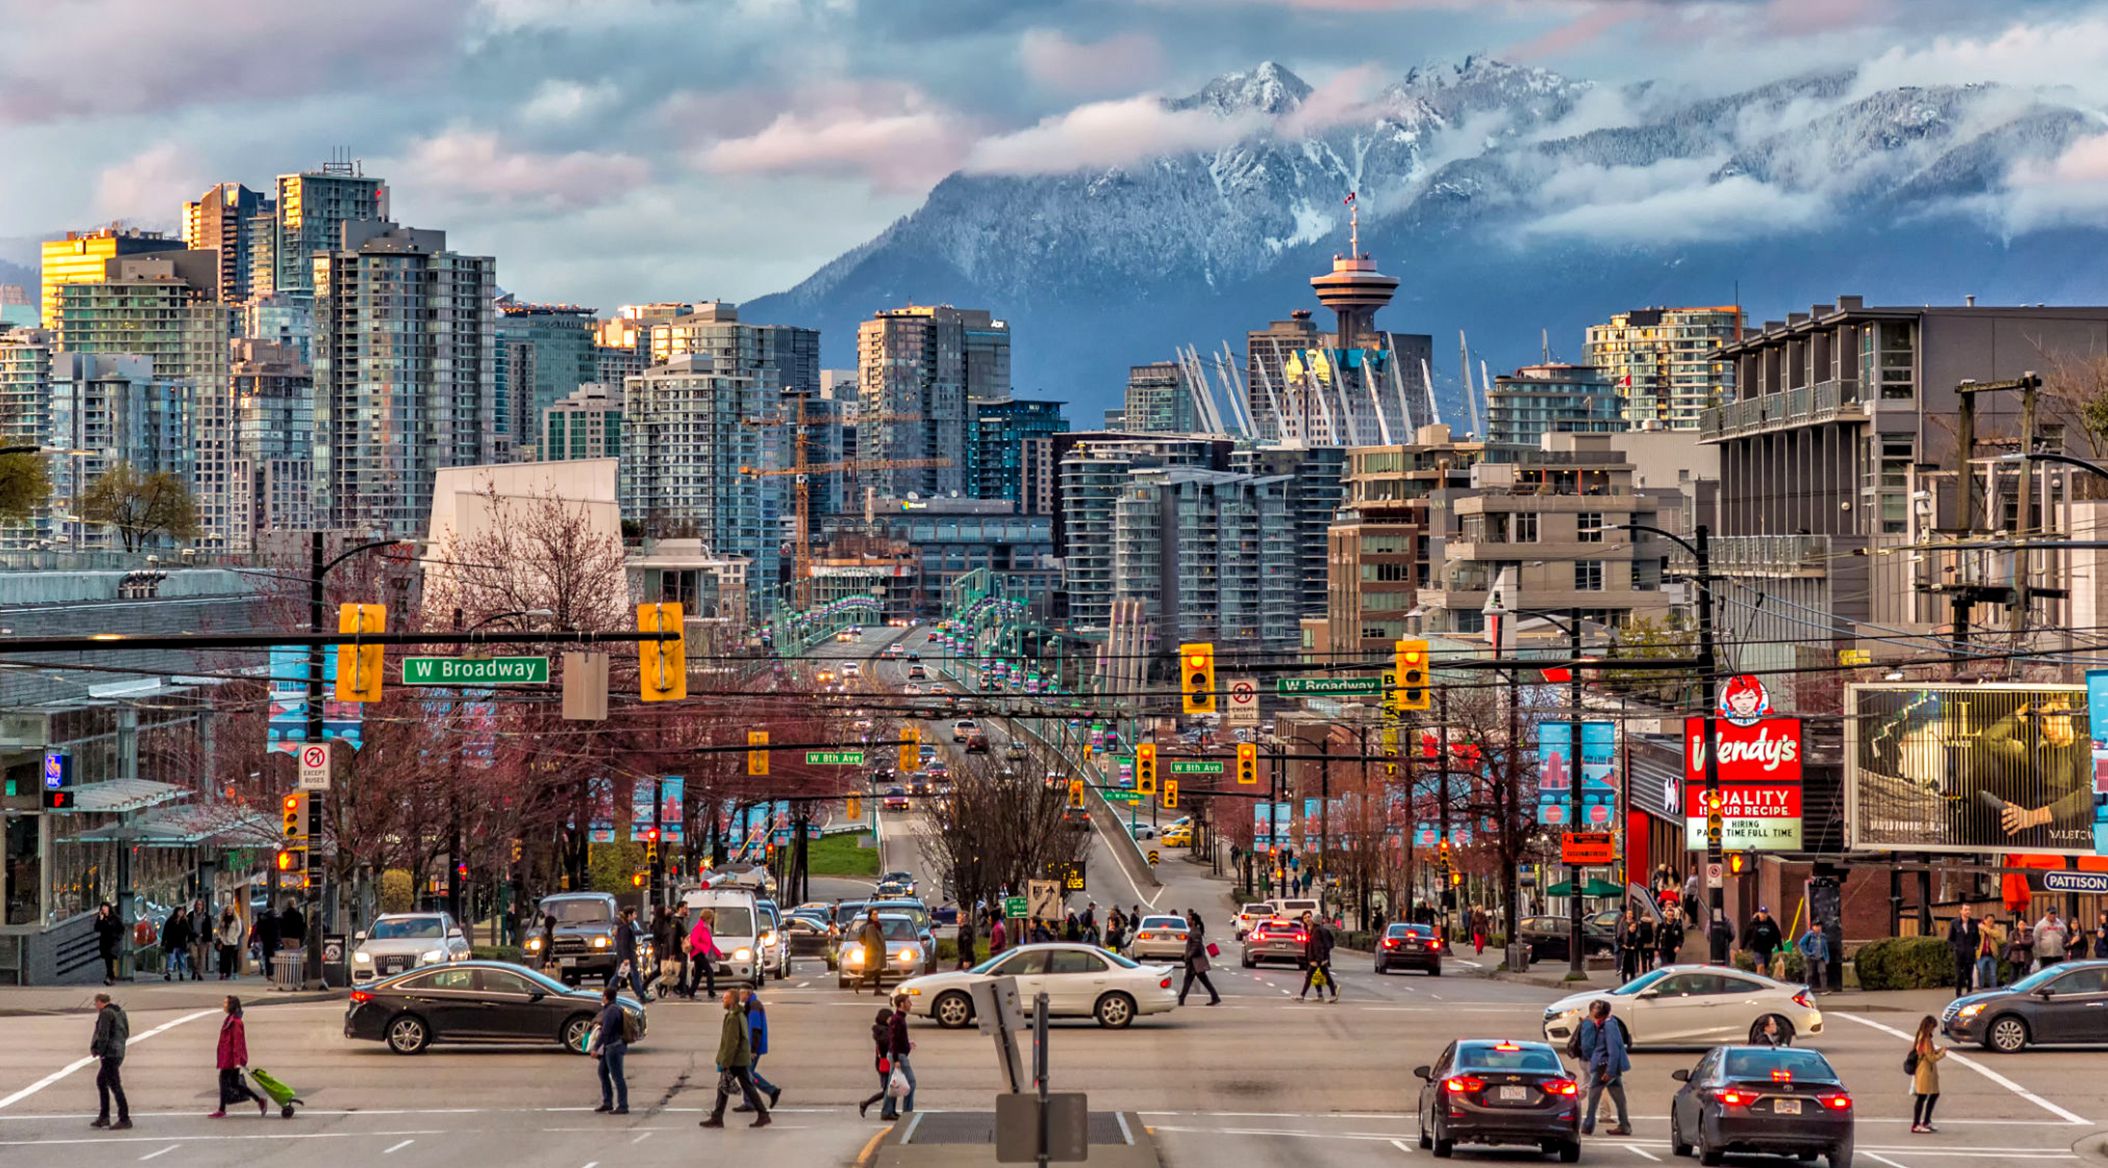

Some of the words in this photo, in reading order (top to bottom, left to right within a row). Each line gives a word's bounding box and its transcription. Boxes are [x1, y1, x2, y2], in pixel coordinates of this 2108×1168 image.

[416, 661, 433, 677] W
[442, 660, 537, 680] Broadway
[1285, 680, 1300, 691] W
[1305, 680, 1376, 693] Broadway
[1693, 727, 1796, 771] Wendy's
[811, 754, 819, 762] W
[823, 754, 838, 762] 8th
[843, 754, 860, 762] Ave
[1174, 763, 1183, 771] W
[1204, 763, 1220, 771] Ave
[303, 769, 326, 777] EXCEPT
[1721, 806, 1741, 815] UR
[1731, 820, 1760, 828] HIRING
[1726, 828, 1746, 837] TIME
[1747, 828, 1768, 837] FULL
[1773, 829, 1793, 837] TIME
[2049, 875, 2107, 889] PATTISON
